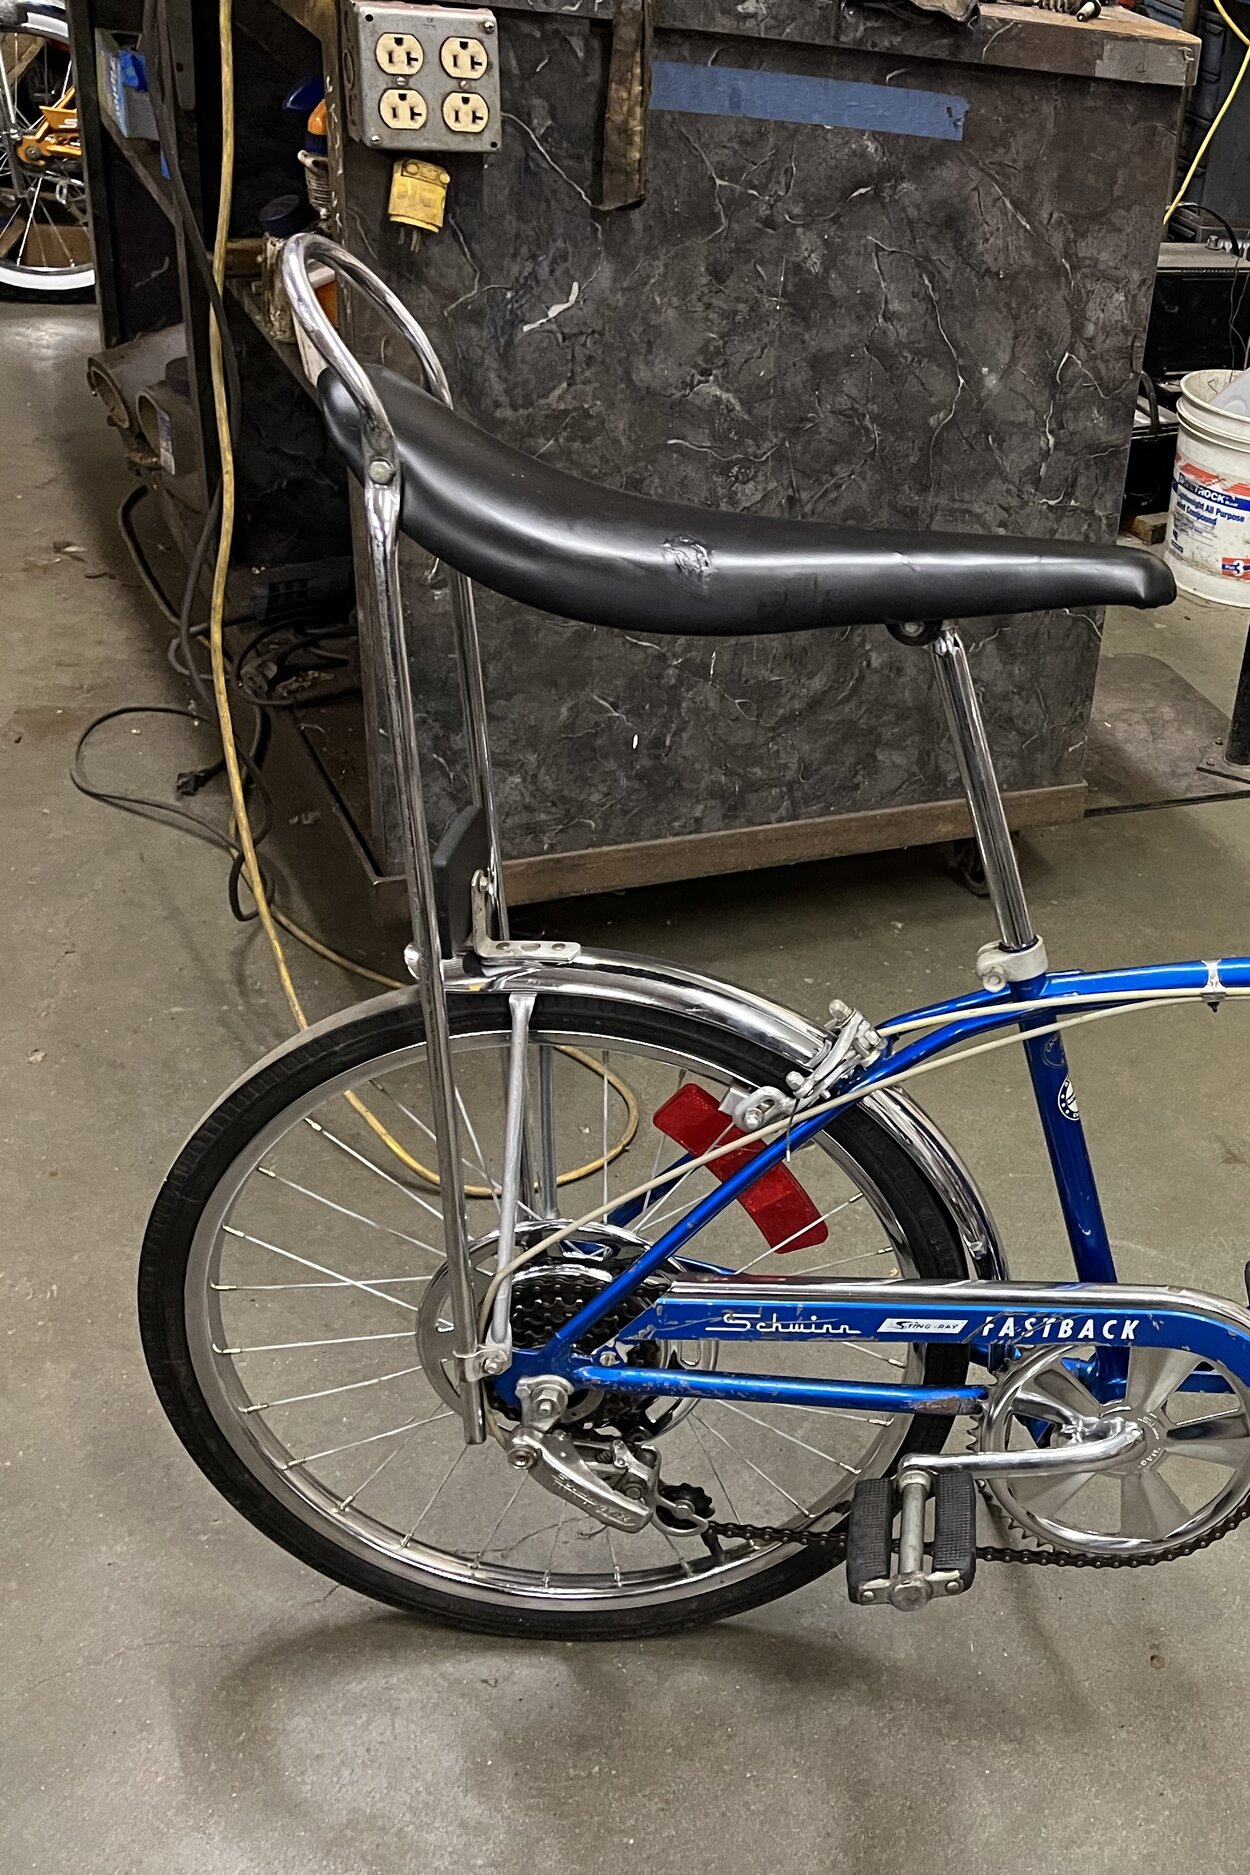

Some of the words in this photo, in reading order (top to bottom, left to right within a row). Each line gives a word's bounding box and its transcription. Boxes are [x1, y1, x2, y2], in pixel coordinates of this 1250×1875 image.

[1215, 507, 1245, 523] Purpose
[1232, 559, 1245, 577] 3
[705, 1313, 862, 1334] Schwinn
[982, 1316, 1140, 1340] FASTBACK
